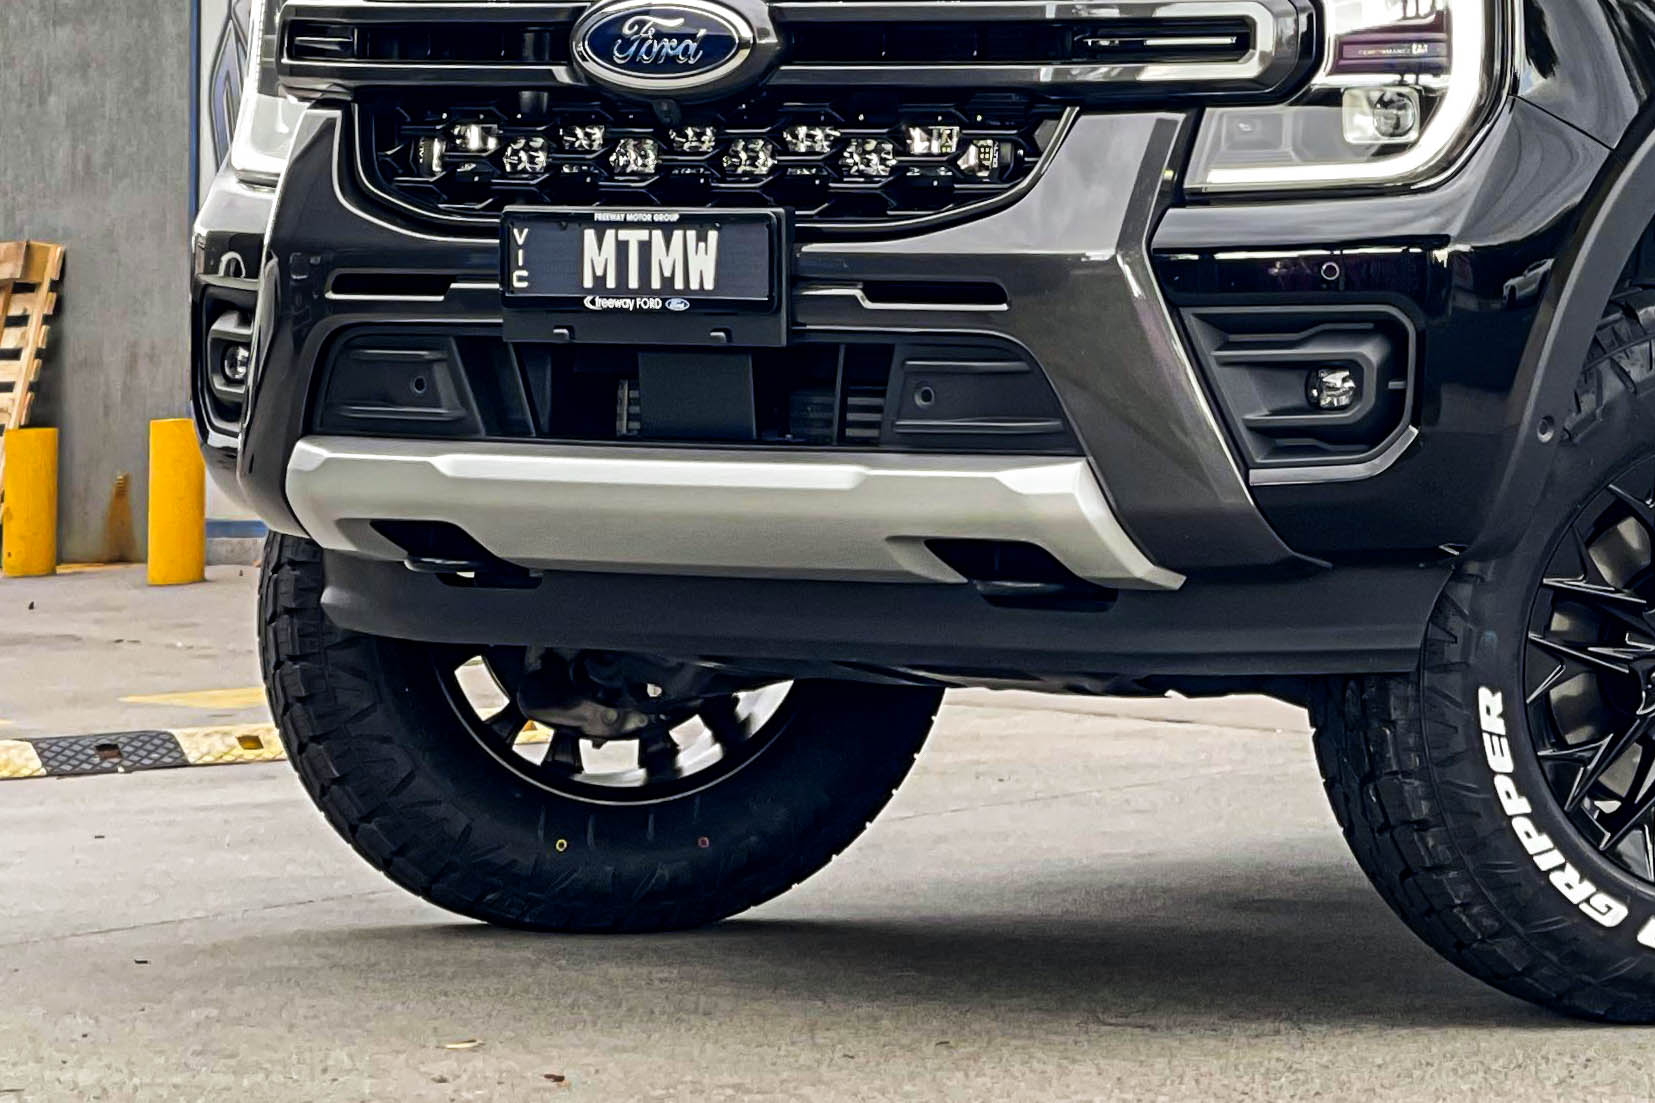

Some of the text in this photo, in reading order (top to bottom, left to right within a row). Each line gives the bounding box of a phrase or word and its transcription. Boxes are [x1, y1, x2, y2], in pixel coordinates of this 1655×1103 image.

[611, 14, 708, 65] Ford
[626, 213, 652, 222] MOTOR
[653, 213, 680, 222] GROUP
[512, 228, 529, 288] VIC
[583, 229, 719, 290] MTMW
[594, 297, 635, 311] freeway
[636, 298, 662, 310] FORD
[1477, 685, 1629, 928] GRIPPER
